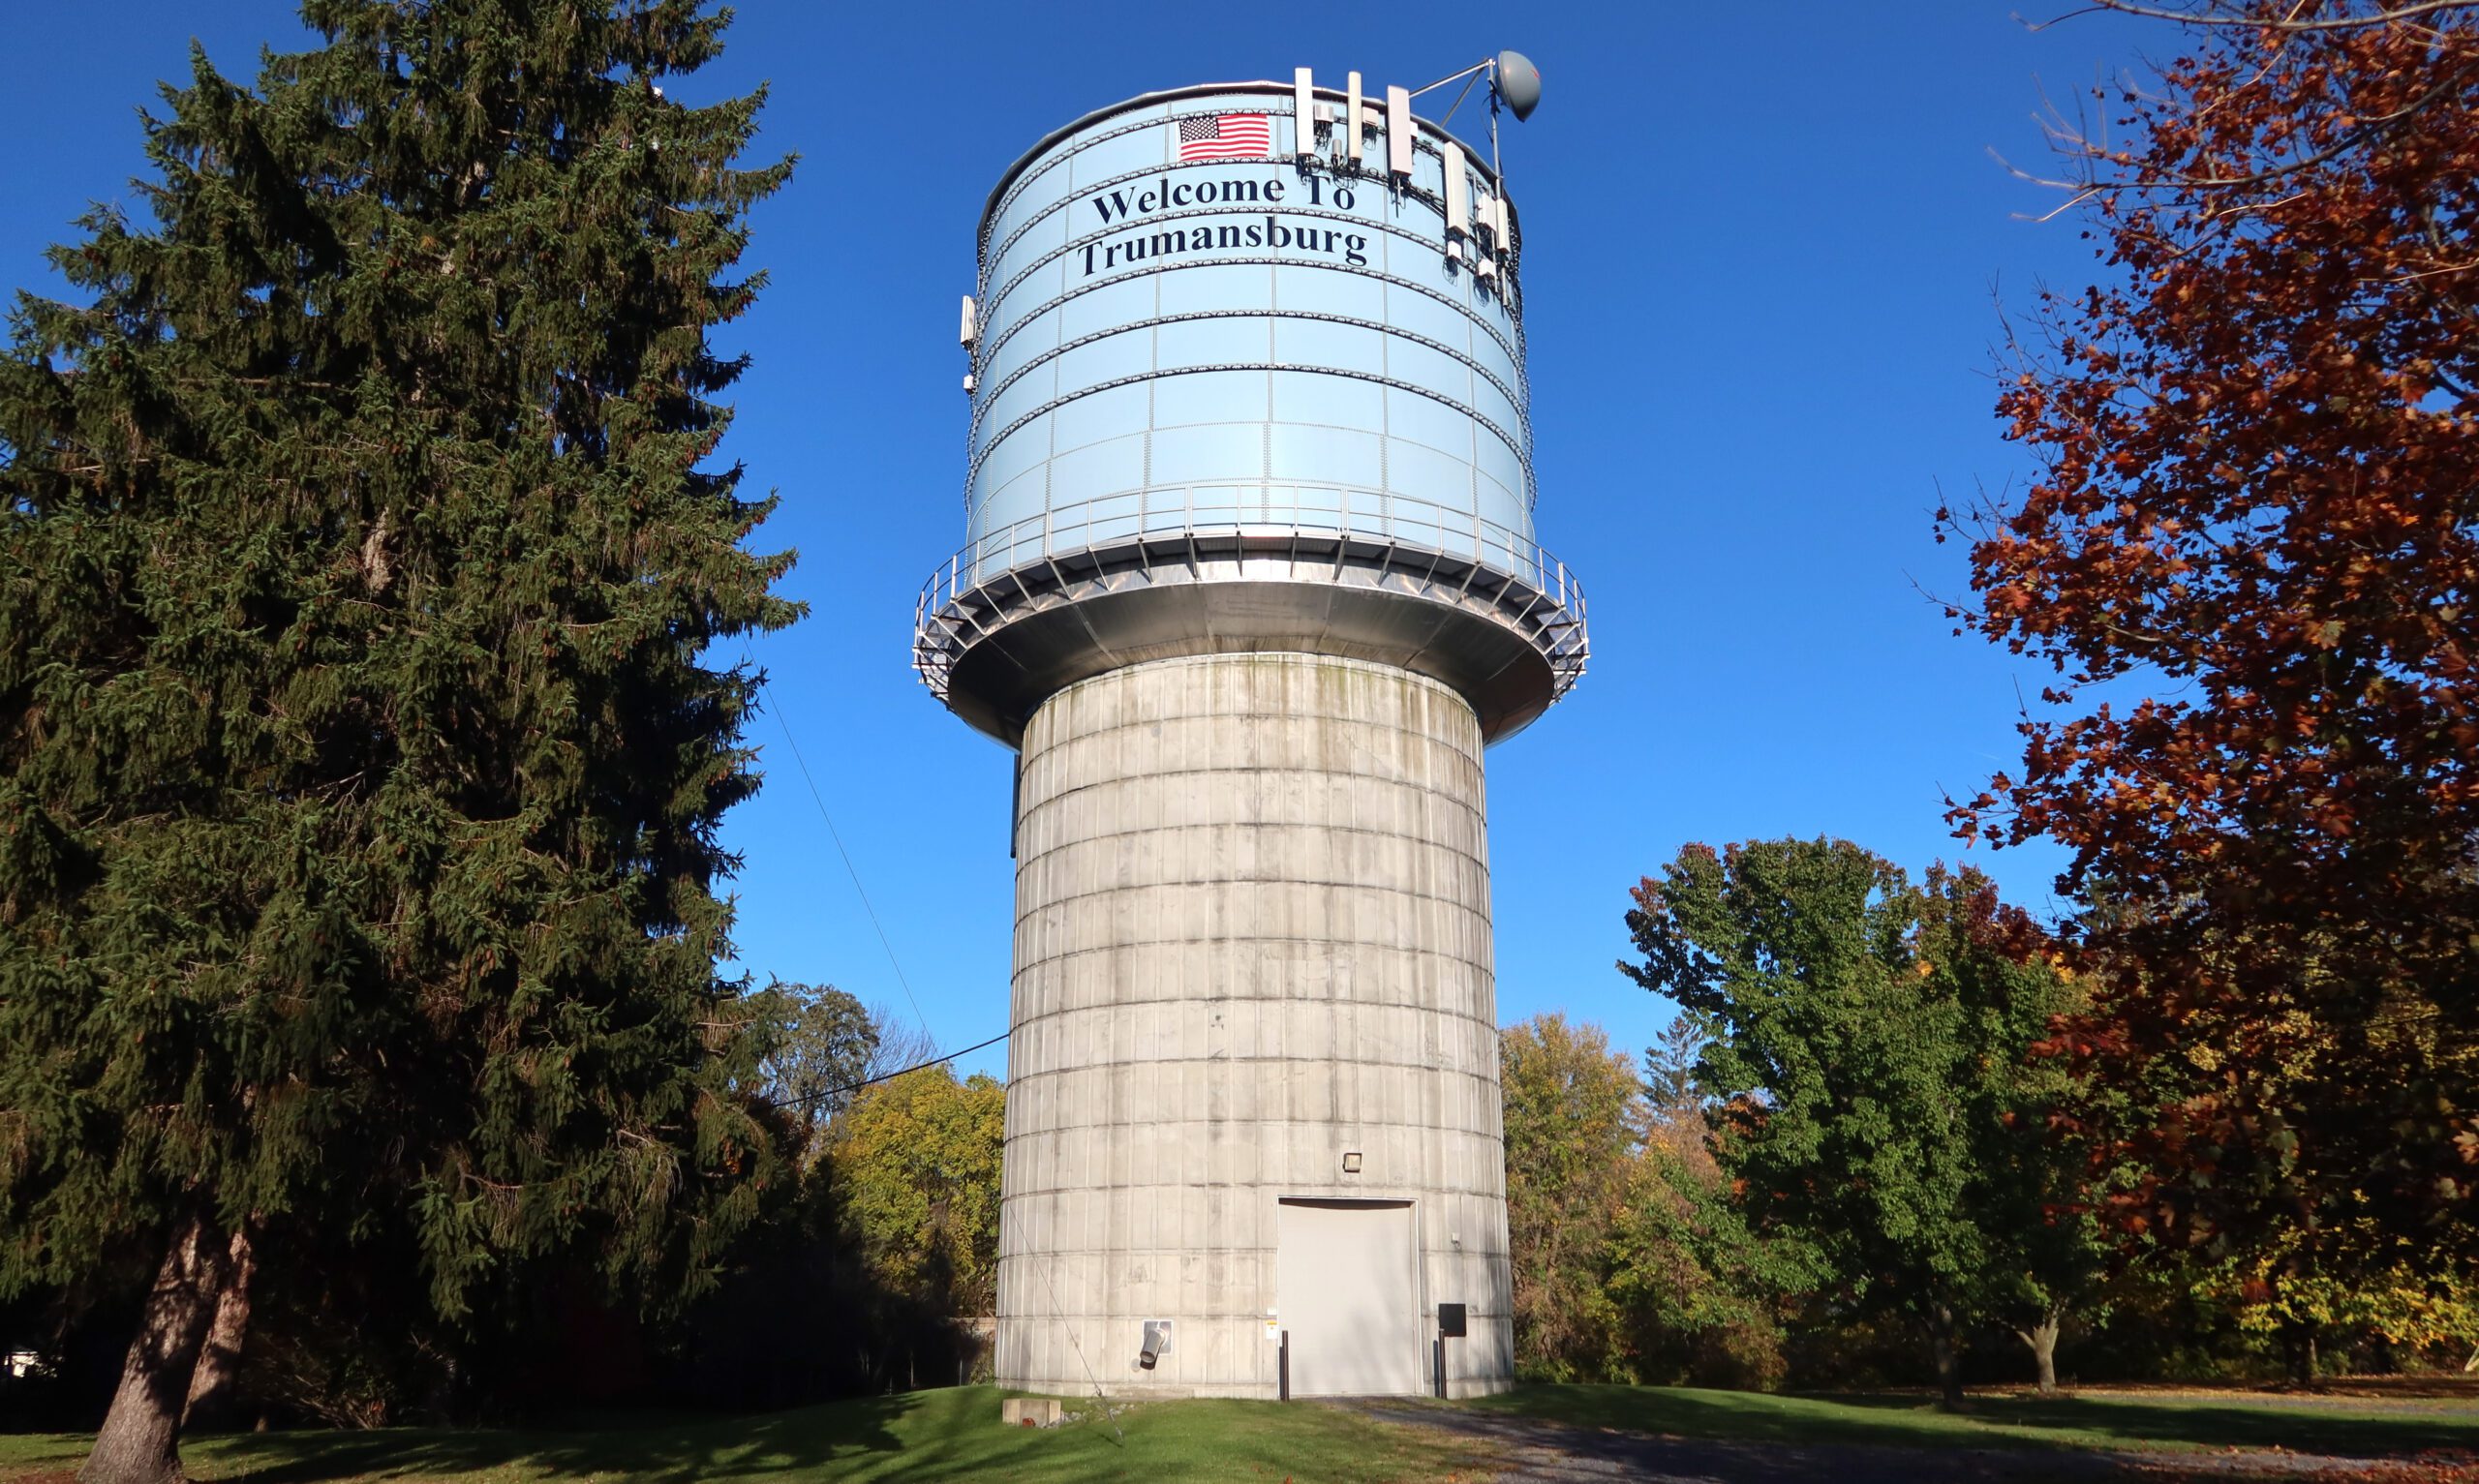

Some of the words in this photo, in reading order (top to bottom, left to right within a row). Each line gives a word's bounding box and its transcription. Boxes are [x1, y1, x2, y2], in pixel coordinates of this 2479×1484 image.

[1091, 178, 1285, 224] Welcome
[1301, 174, 1356, 210] To
[1077, 215, 1367, 277] Trumansburg
